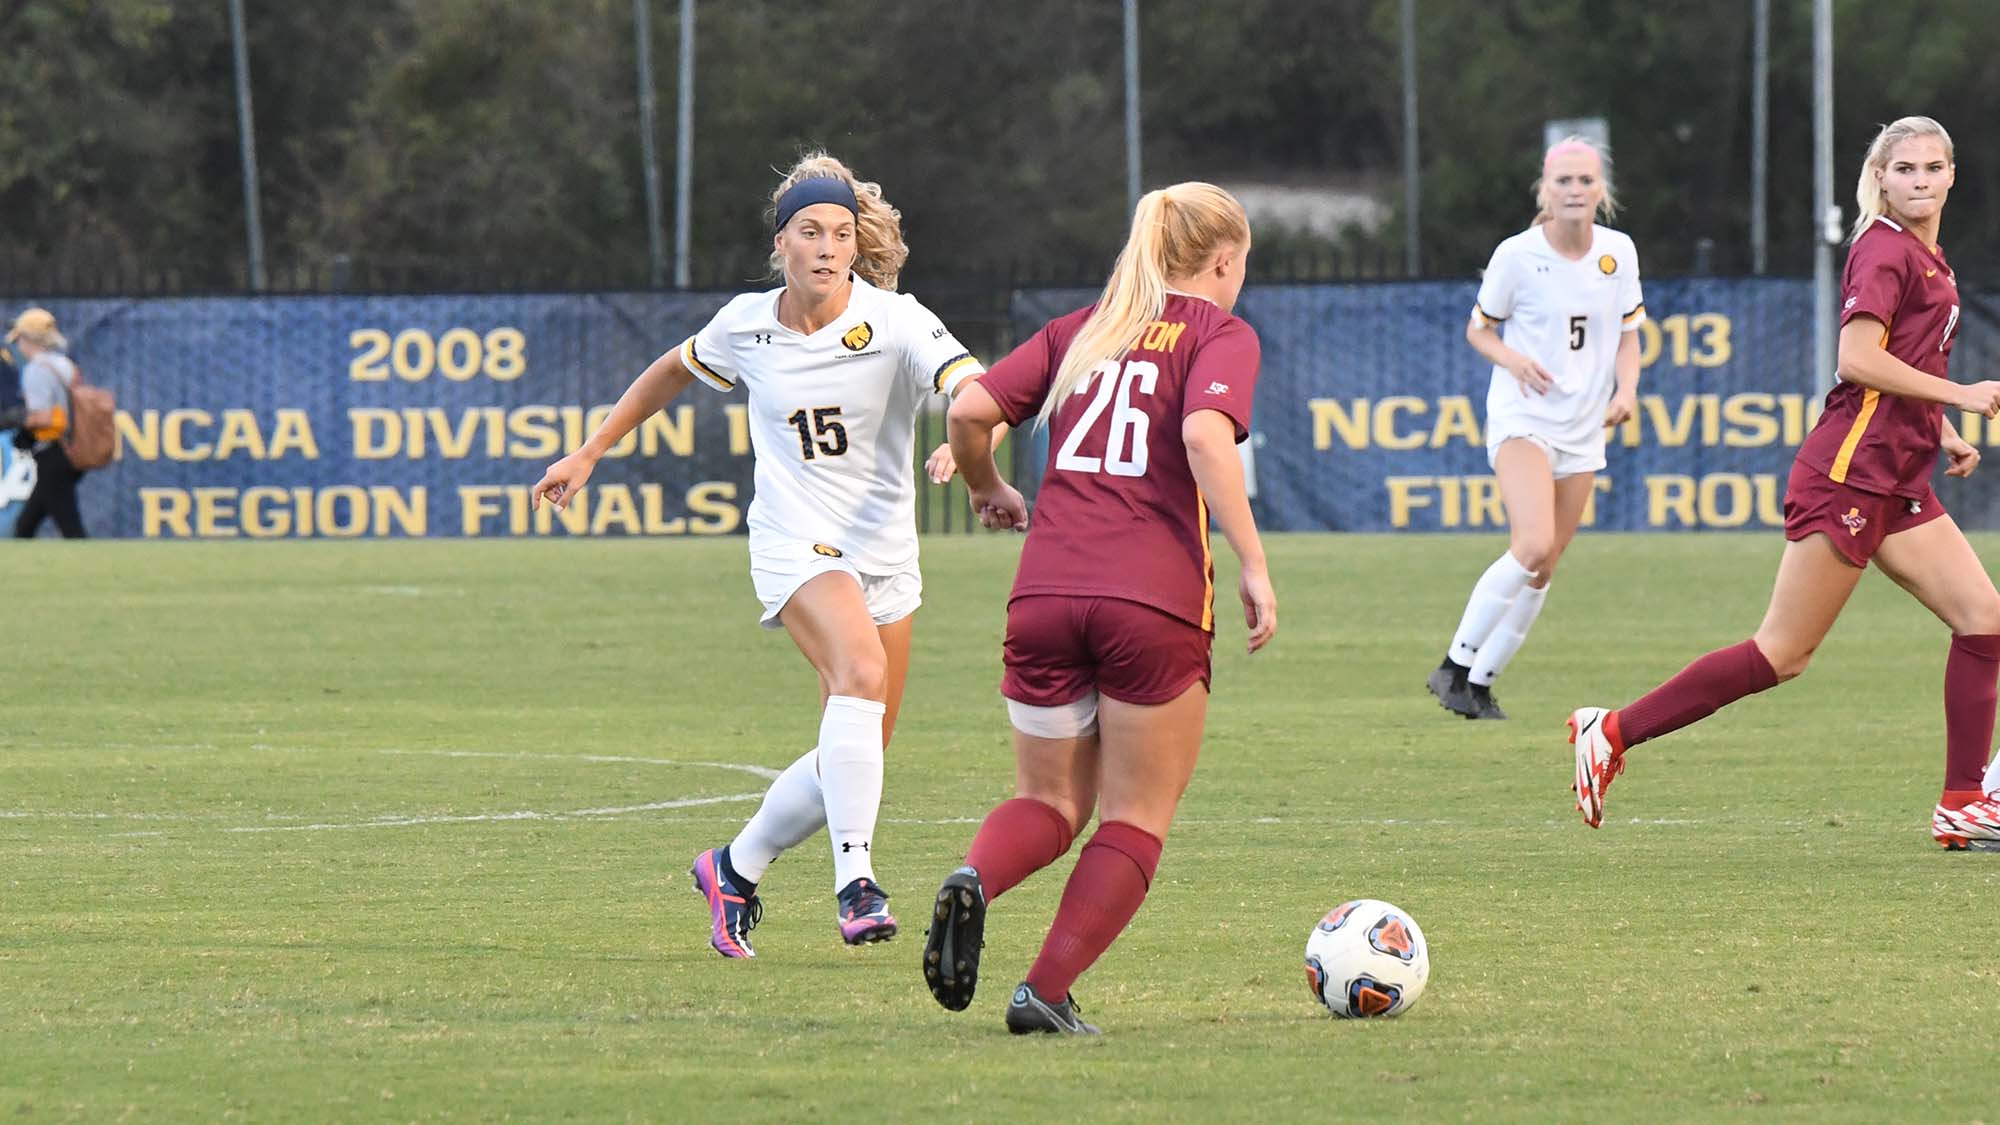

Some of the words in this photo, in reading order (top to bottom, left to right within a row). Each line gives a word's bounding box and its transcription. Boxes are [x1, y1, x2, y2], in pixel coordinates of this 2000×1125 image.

[350, 328, 526, 382] 2008
[1130, 320, 1187, 352] ON
[1569, 316, 1587, 350] 5
[1638, 313, 1732, 368] 013
[113, 407, 319, 462] NCAA
[788, 407, 848, 461] 15
[1055, 359, 1160, 478] 26
[1308, 395, 1488, 450] NCA
[1604, 393, 1820, 448] IVISI
[139, 485, 428, 538] REGION
[458, 482, 741, 535] FINALS
[1385, 474, 1612, 528] FIRT
[1645, 473, 1786, 528] ROU
